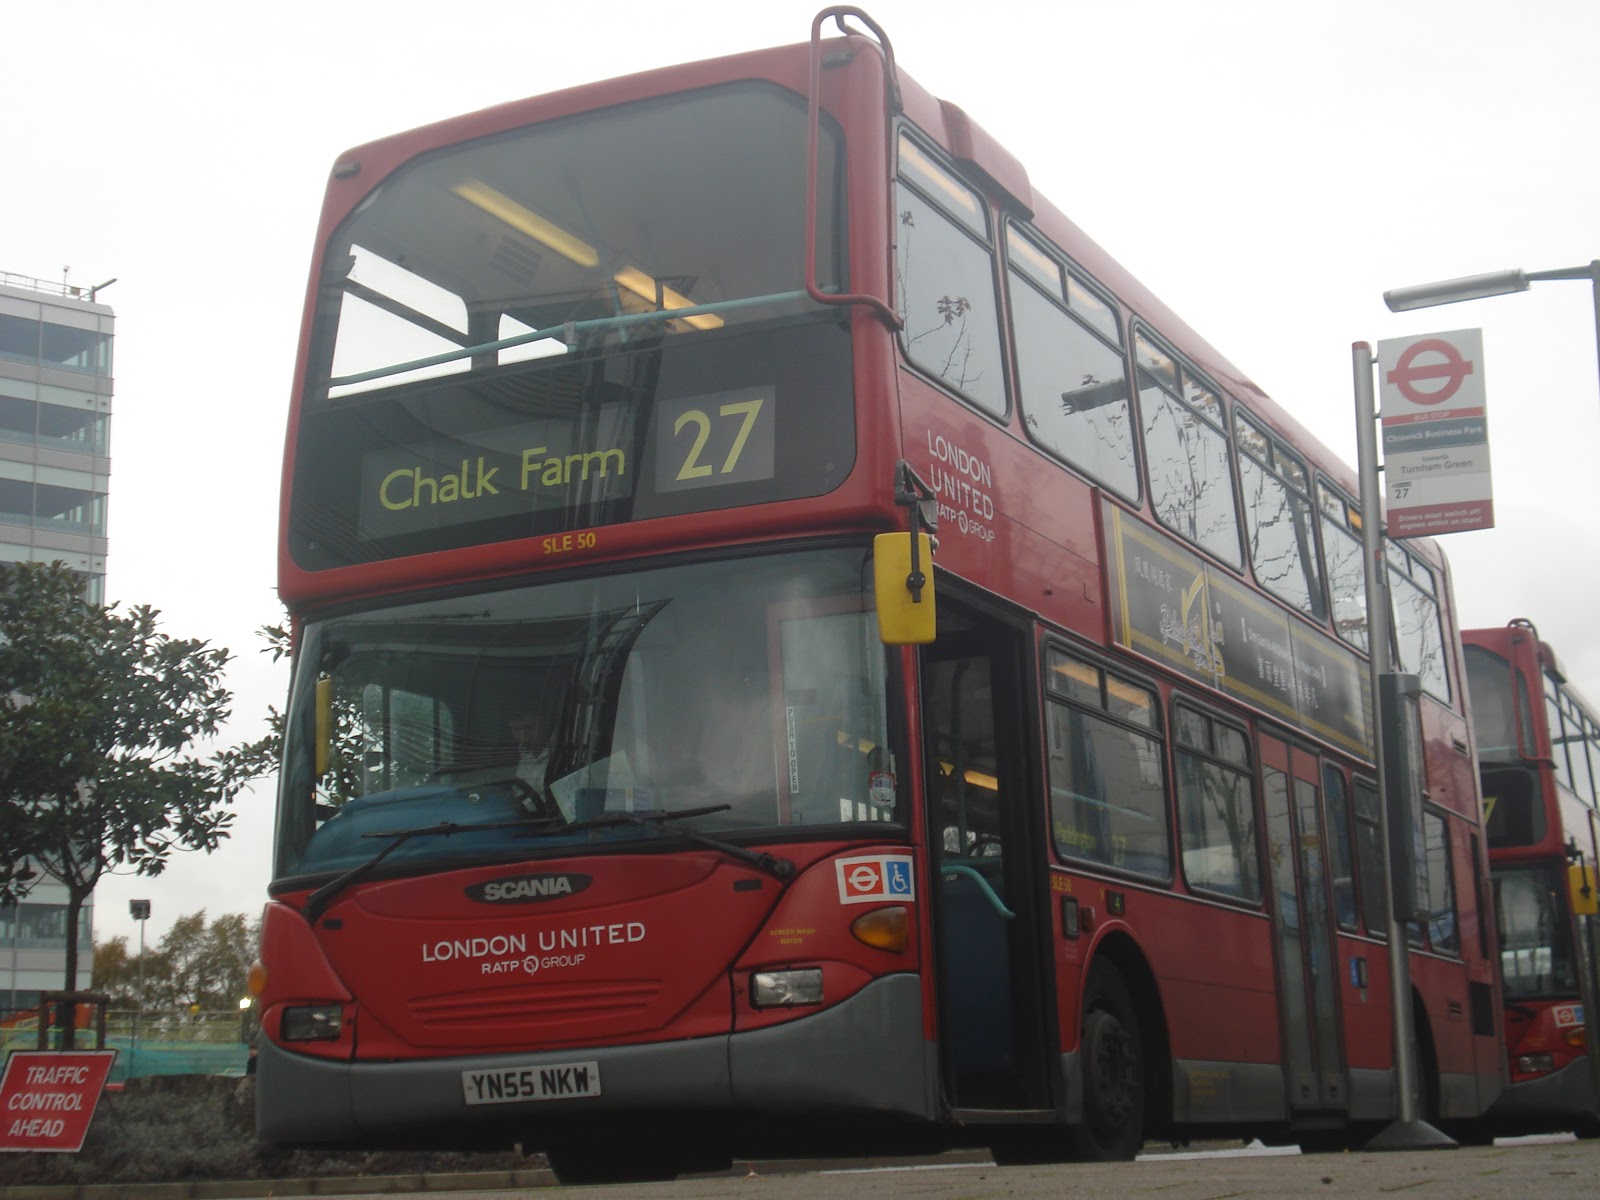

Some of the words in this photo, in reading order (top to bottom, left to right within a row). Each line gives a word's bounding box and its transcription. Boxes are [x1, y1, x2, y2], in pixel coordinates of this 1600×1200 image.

[1430, 410, 1450, 419] STOP
[673, 398, 765, 482] 27
[1424, 427, 1462, 438] Business
[1463, 425, 1483, 435] Park
[928, 430, 991, 488] LONDON
[1400, 463, 1442, 474] Turnham
[1444, 460, 1473, 470] Green
[379, 456, 500, 511] Chalk
[520, 446, 625, 491] Farm
[930, 463, 994, 521] UNITED
[1394, 488, 1409, 499] 27
[968, 519, 995, 542] GROUP
[542, 534, 574, 555] SLE
[577, 532, 597, 550] 50
[484, 876, 573, 901] SCANIA
[422, 933, 527, 962] LONDON
[538, 922, 646, 951] UNITED
[481, 960, 520, 975] RATP
[540, 953, 586, 970] GROUP
[25, 1066, 89, 1085] TRAFFIC
[471, 1071, 535, 1100] YN55
[540, 1066, 589, 1096] NKW
[8, 1092, 83, 1111] CONTROL
[7, 1119, 65, 1137] AHEAD
